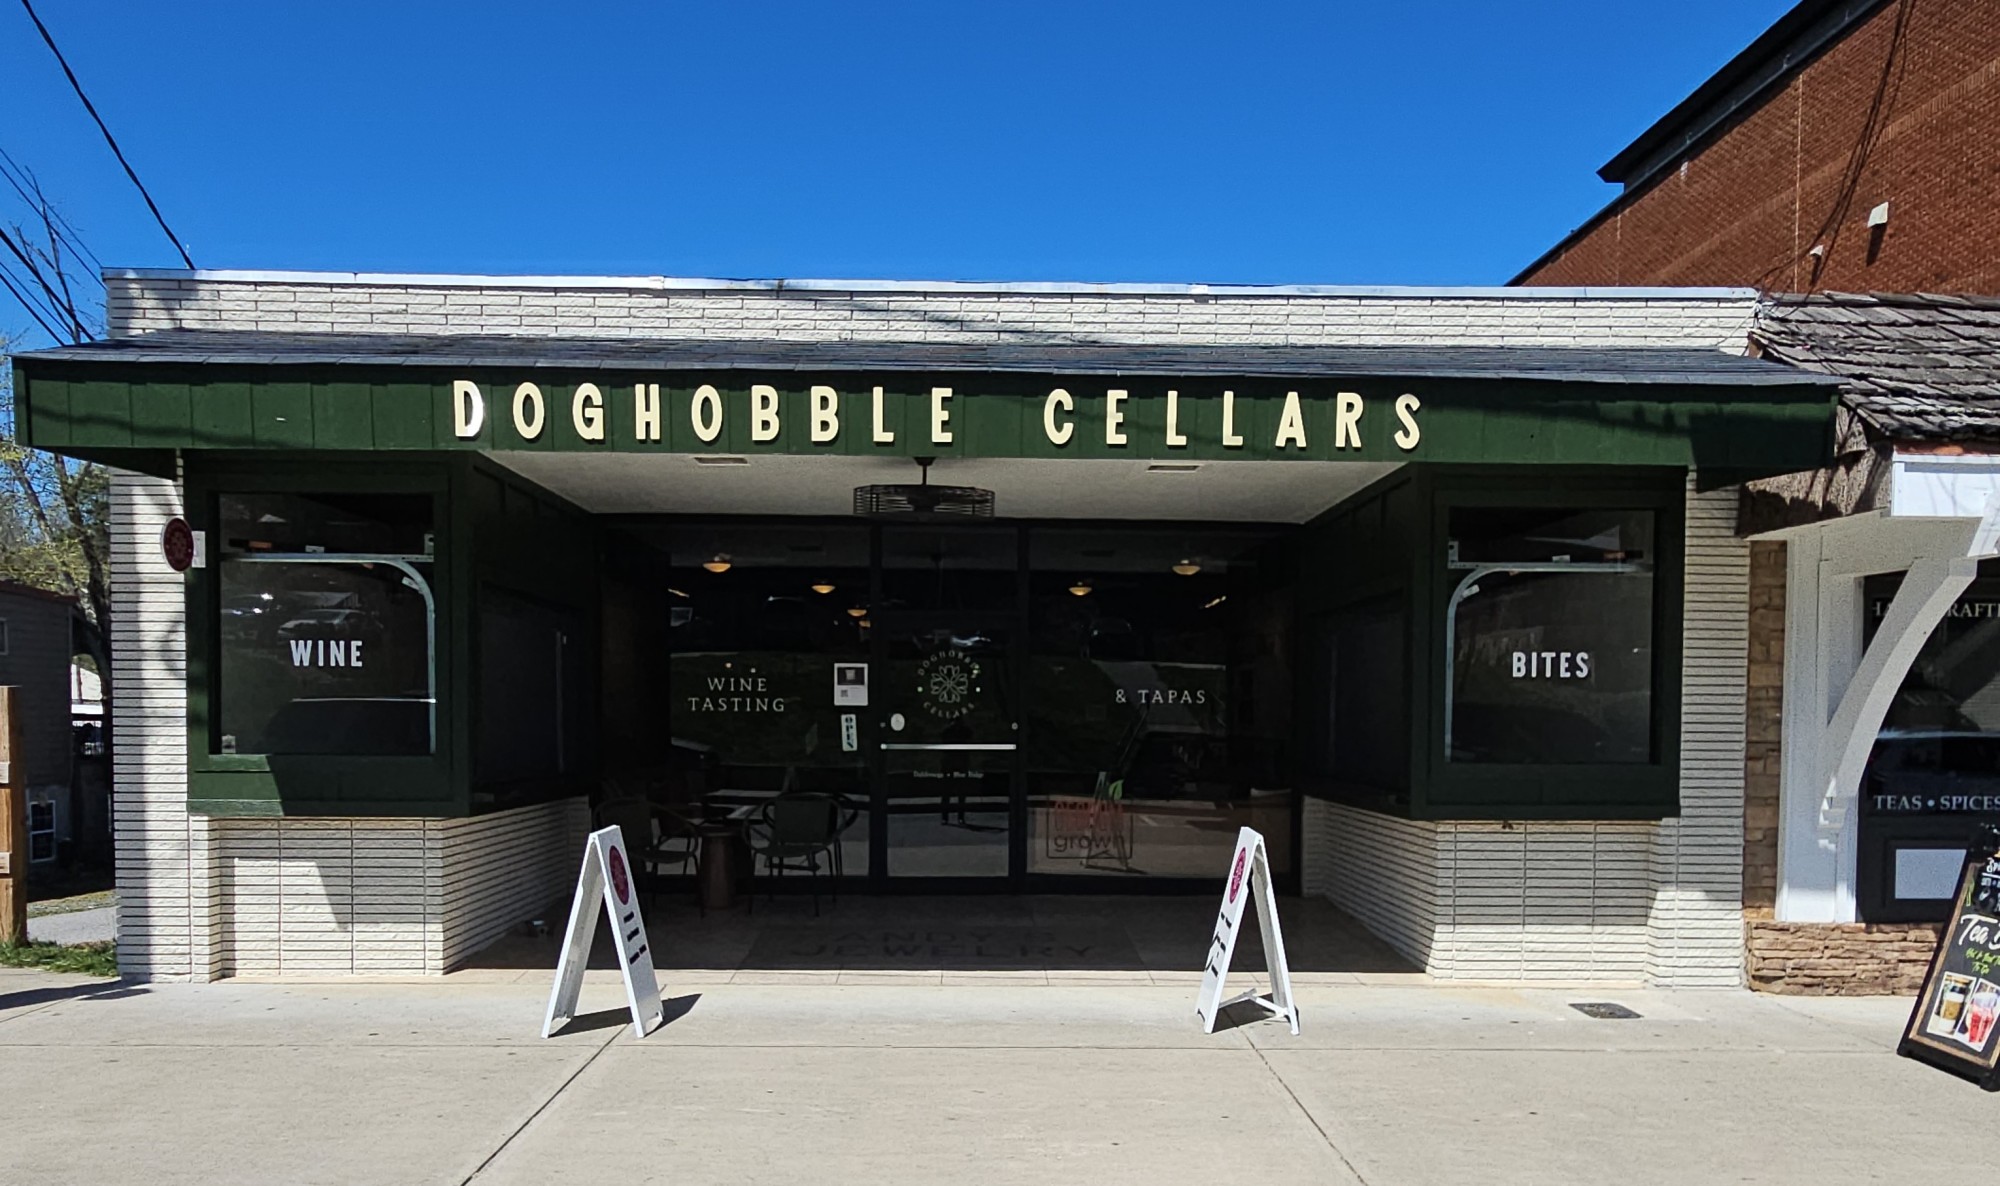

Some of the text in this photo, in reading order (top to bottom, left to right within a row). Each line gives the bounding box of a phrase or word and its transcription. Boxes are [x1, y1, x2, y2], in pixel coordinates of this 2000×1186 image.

[453, 380, 1421, 450] DOGHOBBLE CELLARS
[290, 640, 363, 667] WINE
[1512, 652, 1589, 678] BITES
[707, 677, 767, 692] WINE
[687, 697, 785, 712] TASTING
[1115, 689, 1206, 704] & TAPAS
[923, 701, 976, 719] CELLARS
[1873, 795, 1922, 810] TEAS
[1958, 914, 1999, 946] Tea
[790, 944, 1096, 957] JEWELRY
